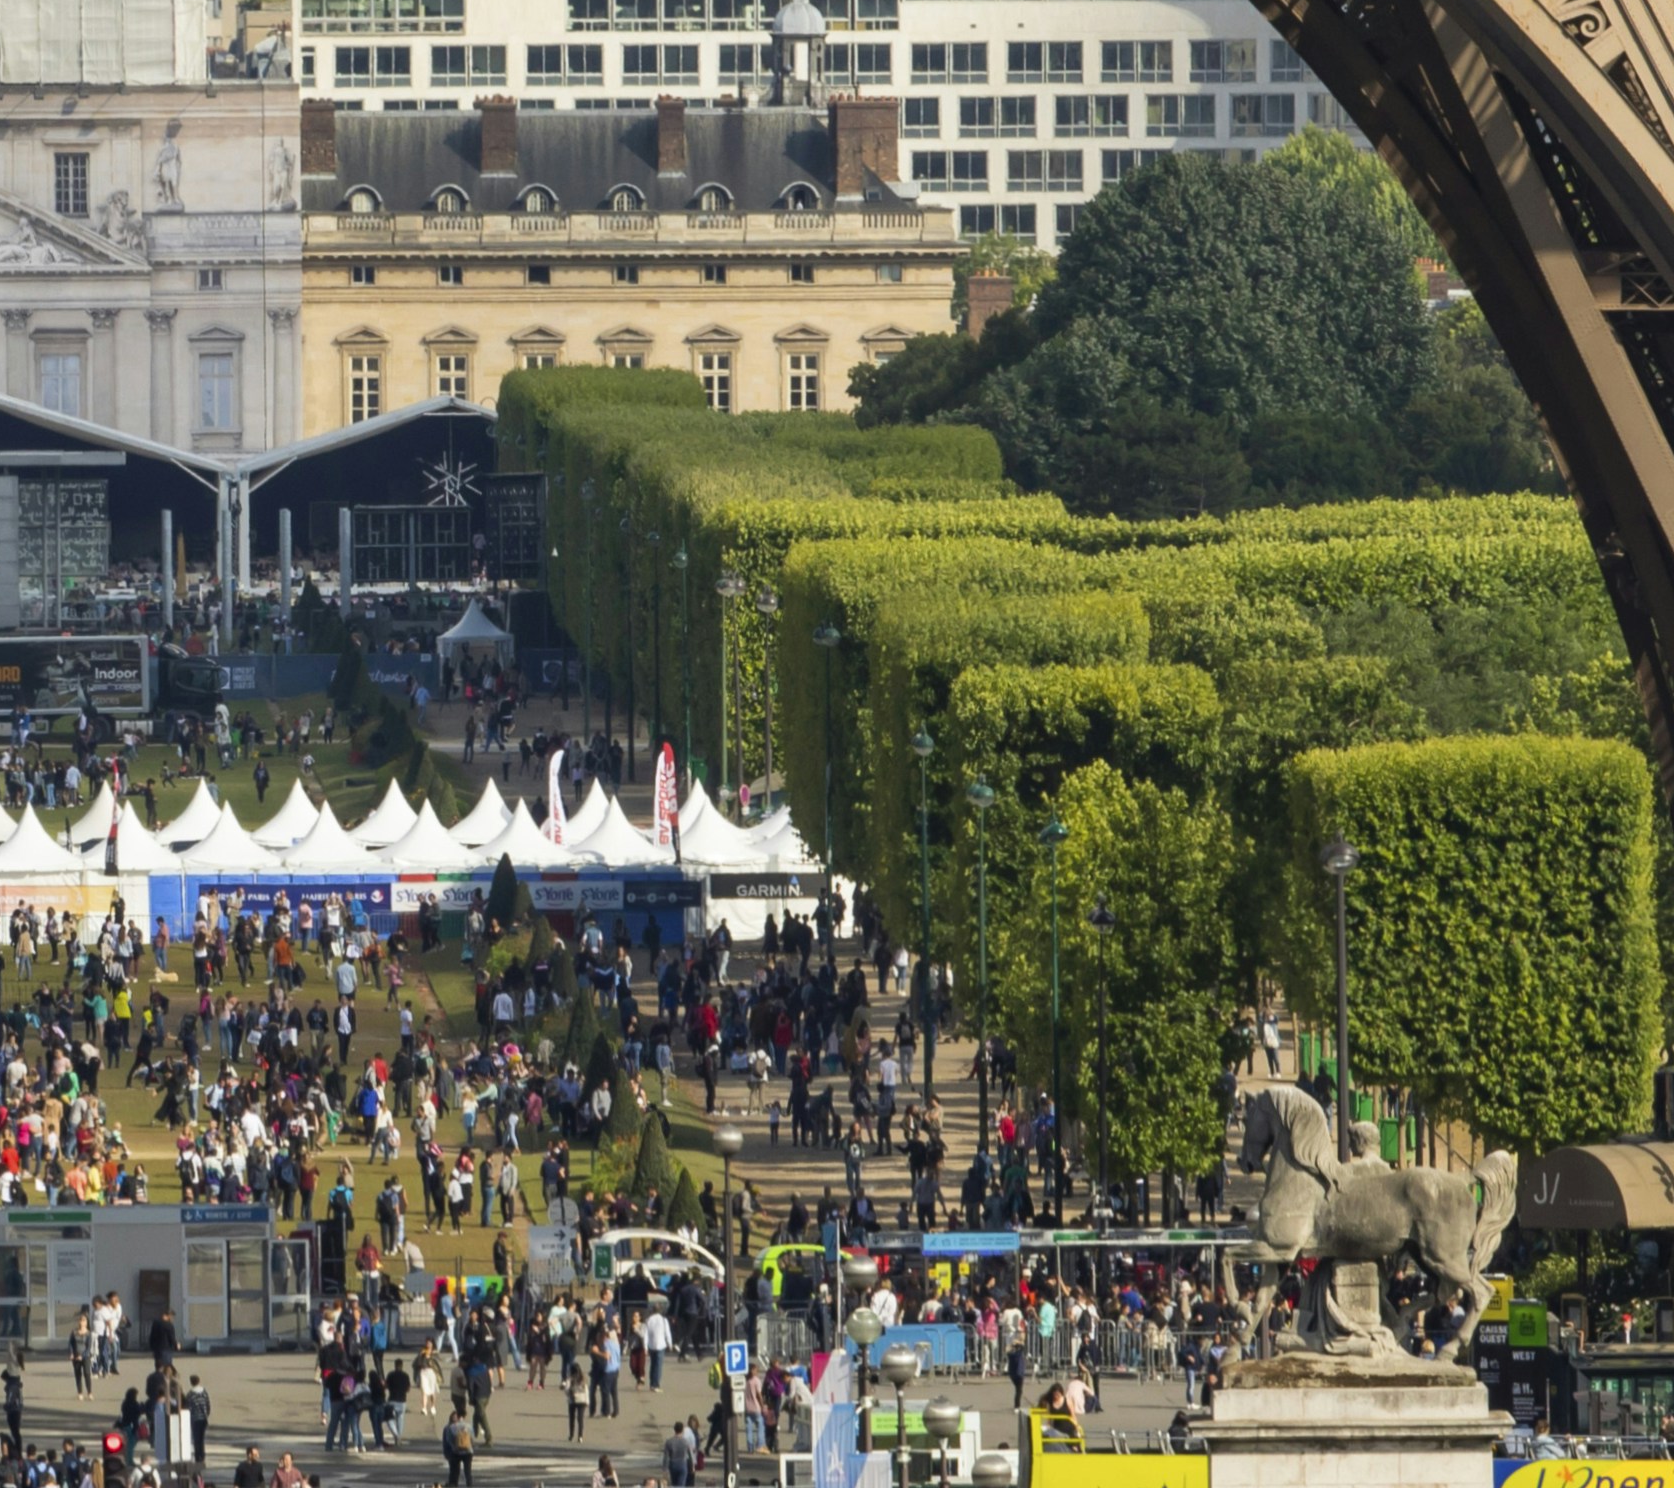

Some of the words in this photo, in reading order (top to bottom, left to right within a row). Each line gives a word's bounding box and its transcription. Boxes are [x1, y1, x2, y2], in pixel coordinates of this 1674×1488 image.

[95, 667, 137, 680] Indoor
[736, 884, 801, 897] GARMIN
[1479, 1325, 1508, 1334] CAISSE
[1479, 1334, 1507, 1344] OUEST
[731, 1348, 743, 1368] P
[1512, 1351, 1536, 1361] WEST
